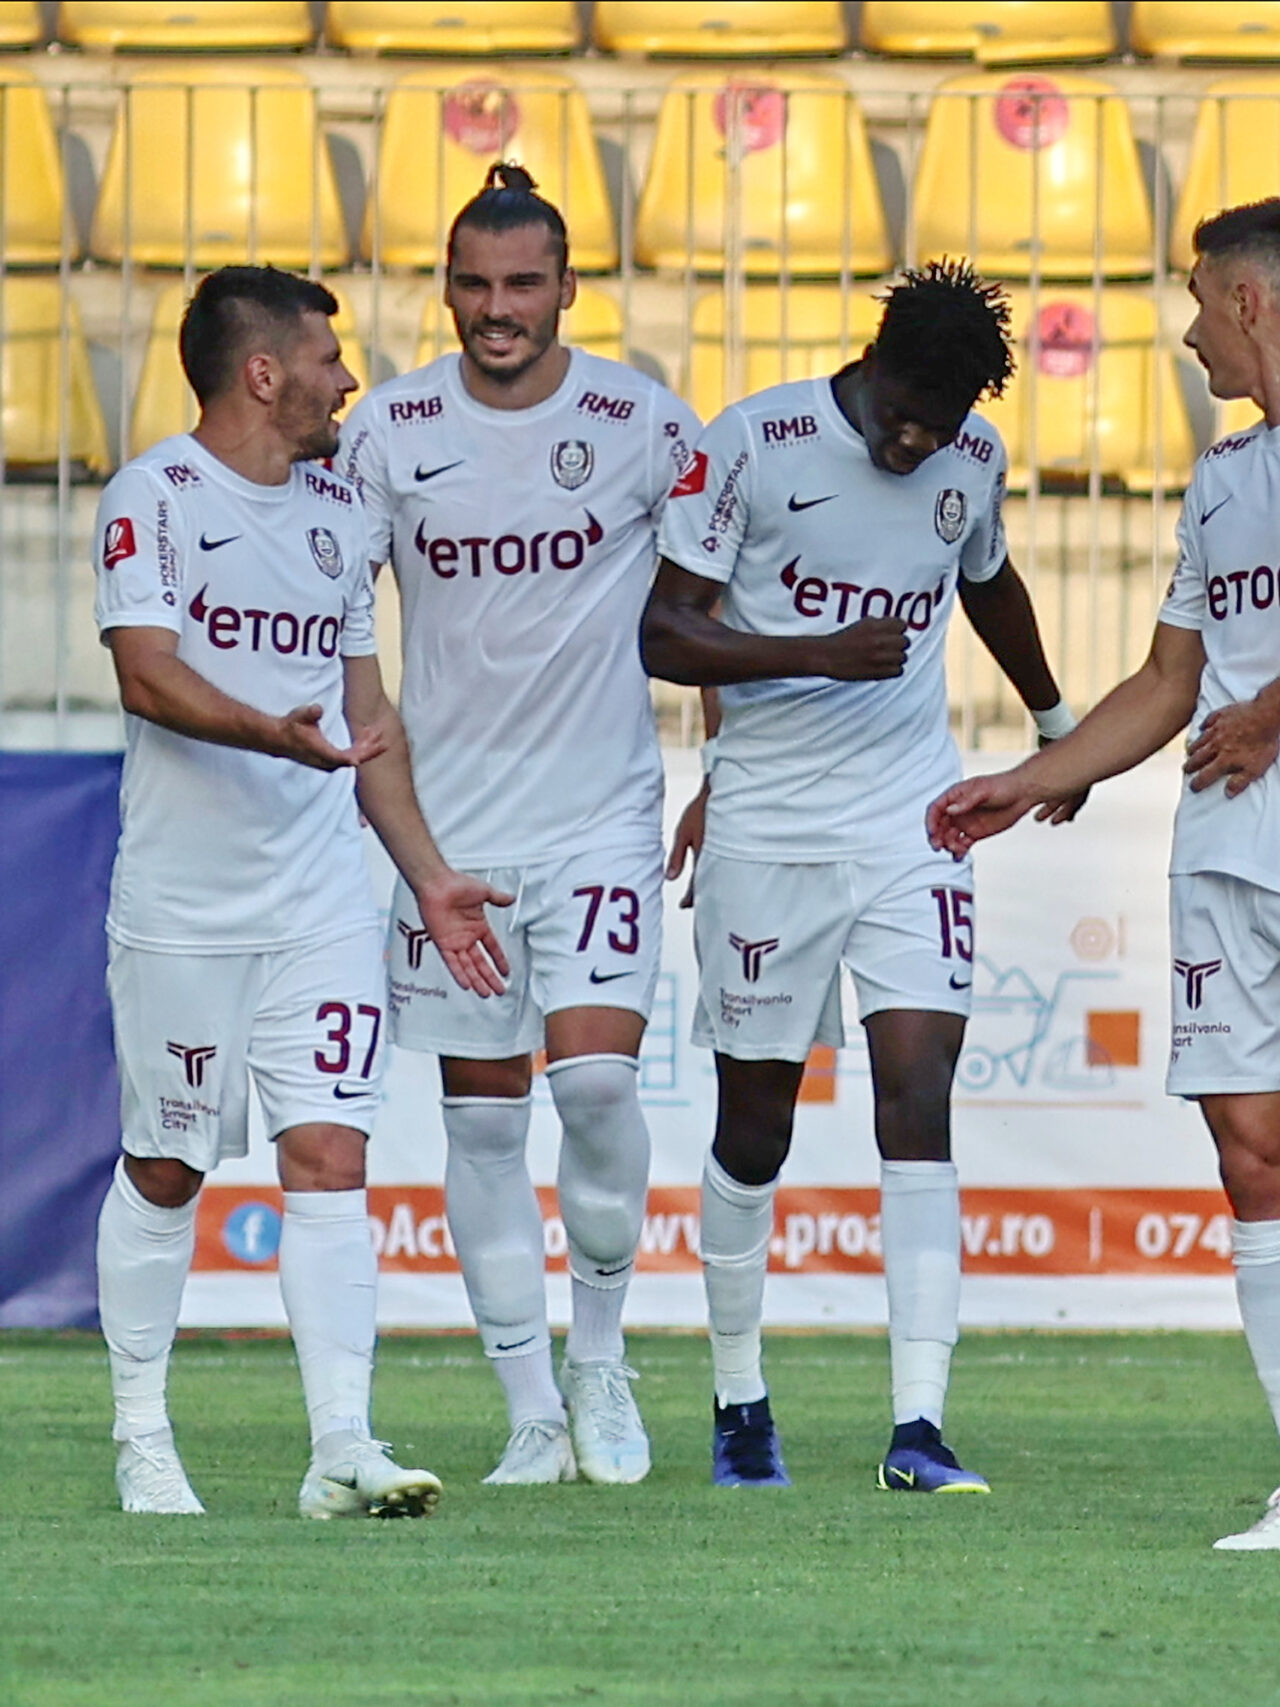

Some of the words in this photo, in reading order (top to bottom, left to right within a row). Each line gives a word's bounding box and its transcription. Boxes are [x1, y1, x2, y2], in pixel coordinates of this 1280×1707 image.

[389, 396, 443, 421] RMB
[577, 391, 635, 420] RMB
[762, 415, 818, 443] RMB
[305, 472, 354, 505] RMB
[157, 500, 171, 586] POKERSTARS
[572, 884, 641, 955] 73
[931, 887, 973, 960] 15
[314, 1002, 382, 1079] 37
[1172, 1021, 1231, 1034] nsilvania
